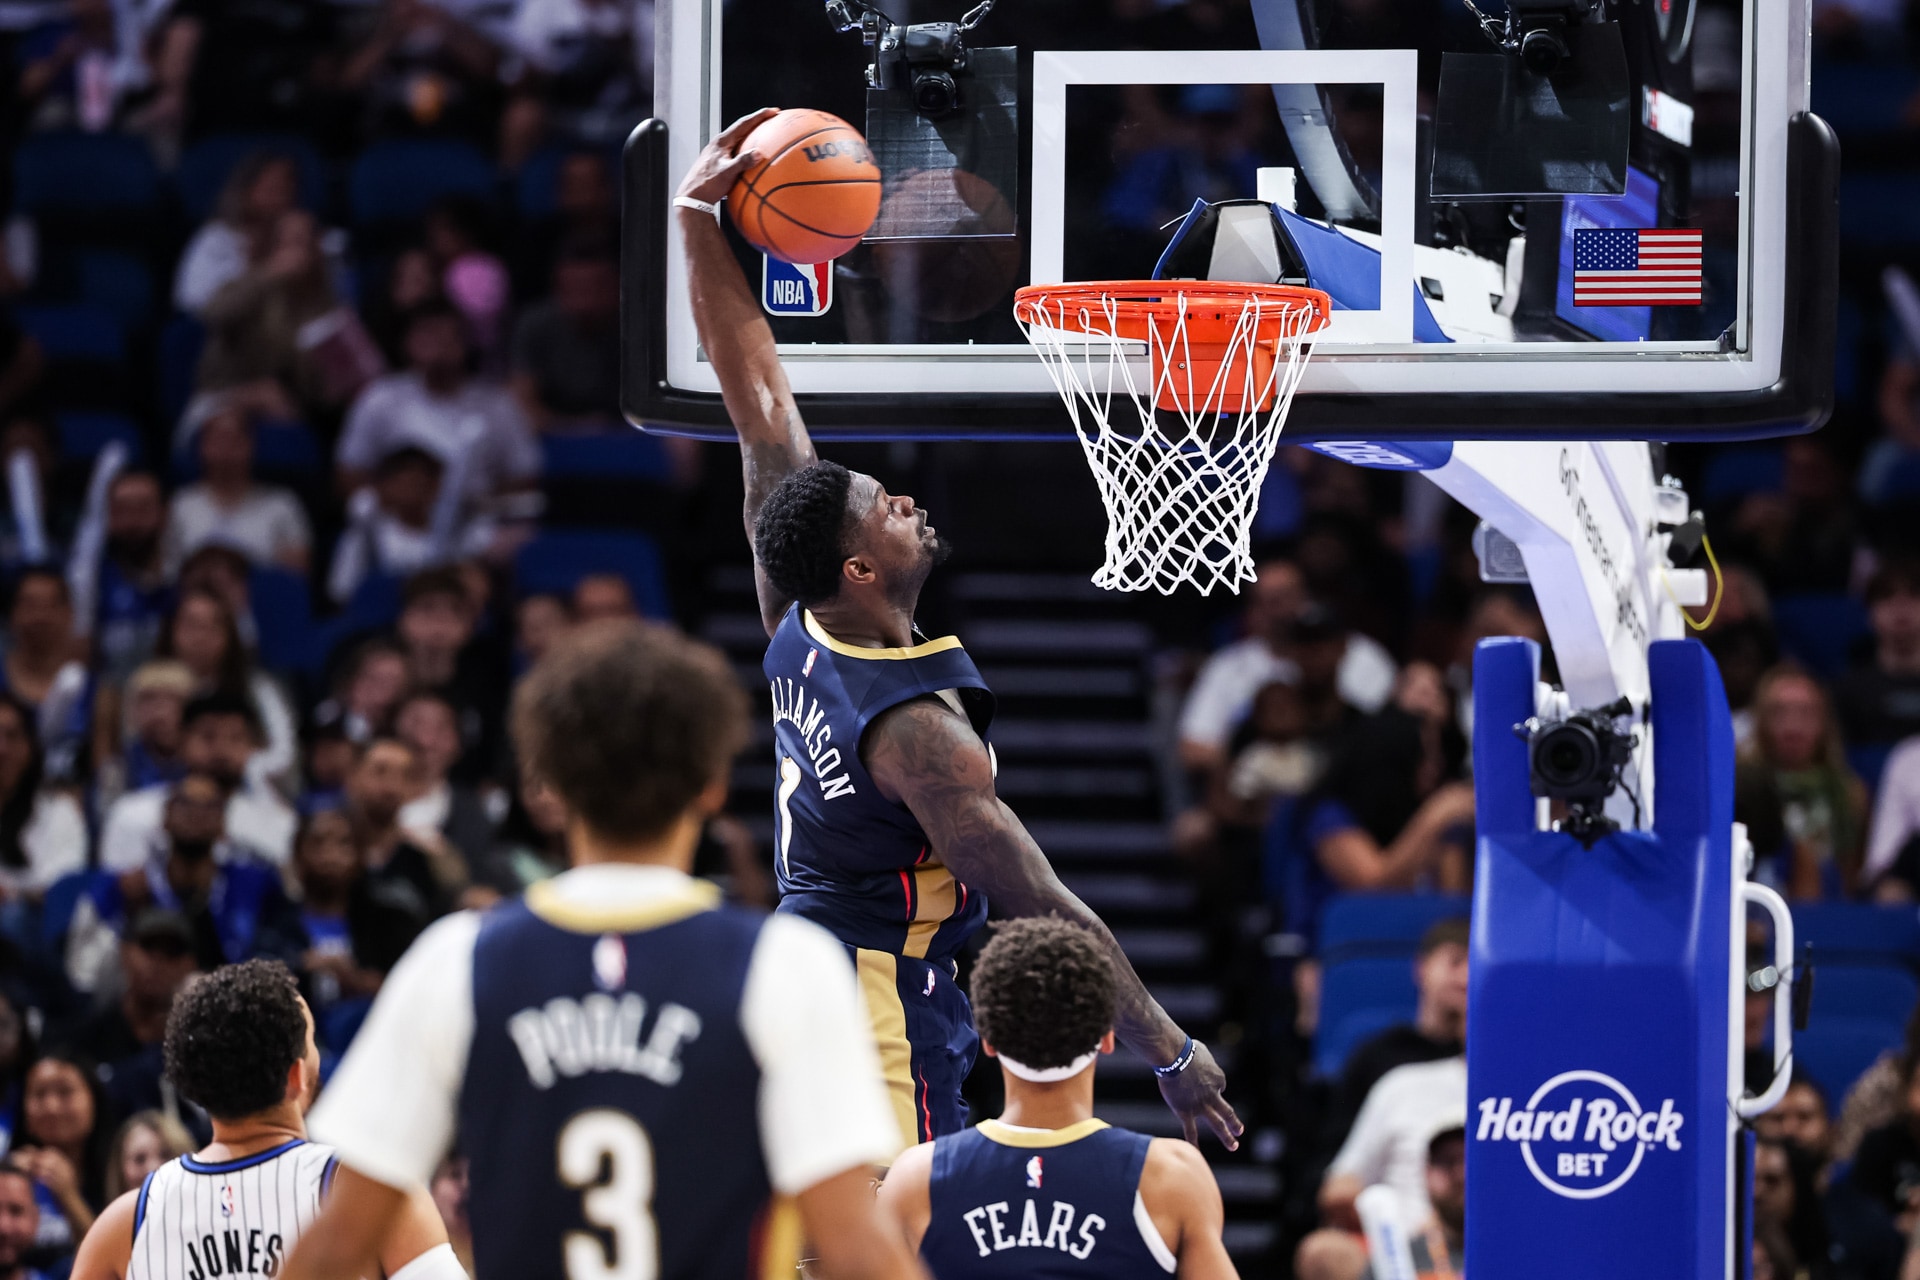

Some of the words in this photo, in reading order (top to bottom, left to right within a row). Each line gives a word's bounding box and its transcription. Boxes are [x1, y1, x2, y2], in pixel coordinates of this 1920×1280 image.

[773, 280, 805, 305] NBA
[771, 676, 856, 801] LLIAMSON
[508, 992, 702, 1090] POOLE
[1476, 1097, 1583, 1142] Hard
[1583, 1098, 1684, 1151] Rock
[1557, 1152, 1609, 1177] BET
[557, 1108, 660, 1280] 3
[187, 1229, 284, 1280] JONES
[963, 1199, 1106, 1260] FEARS
